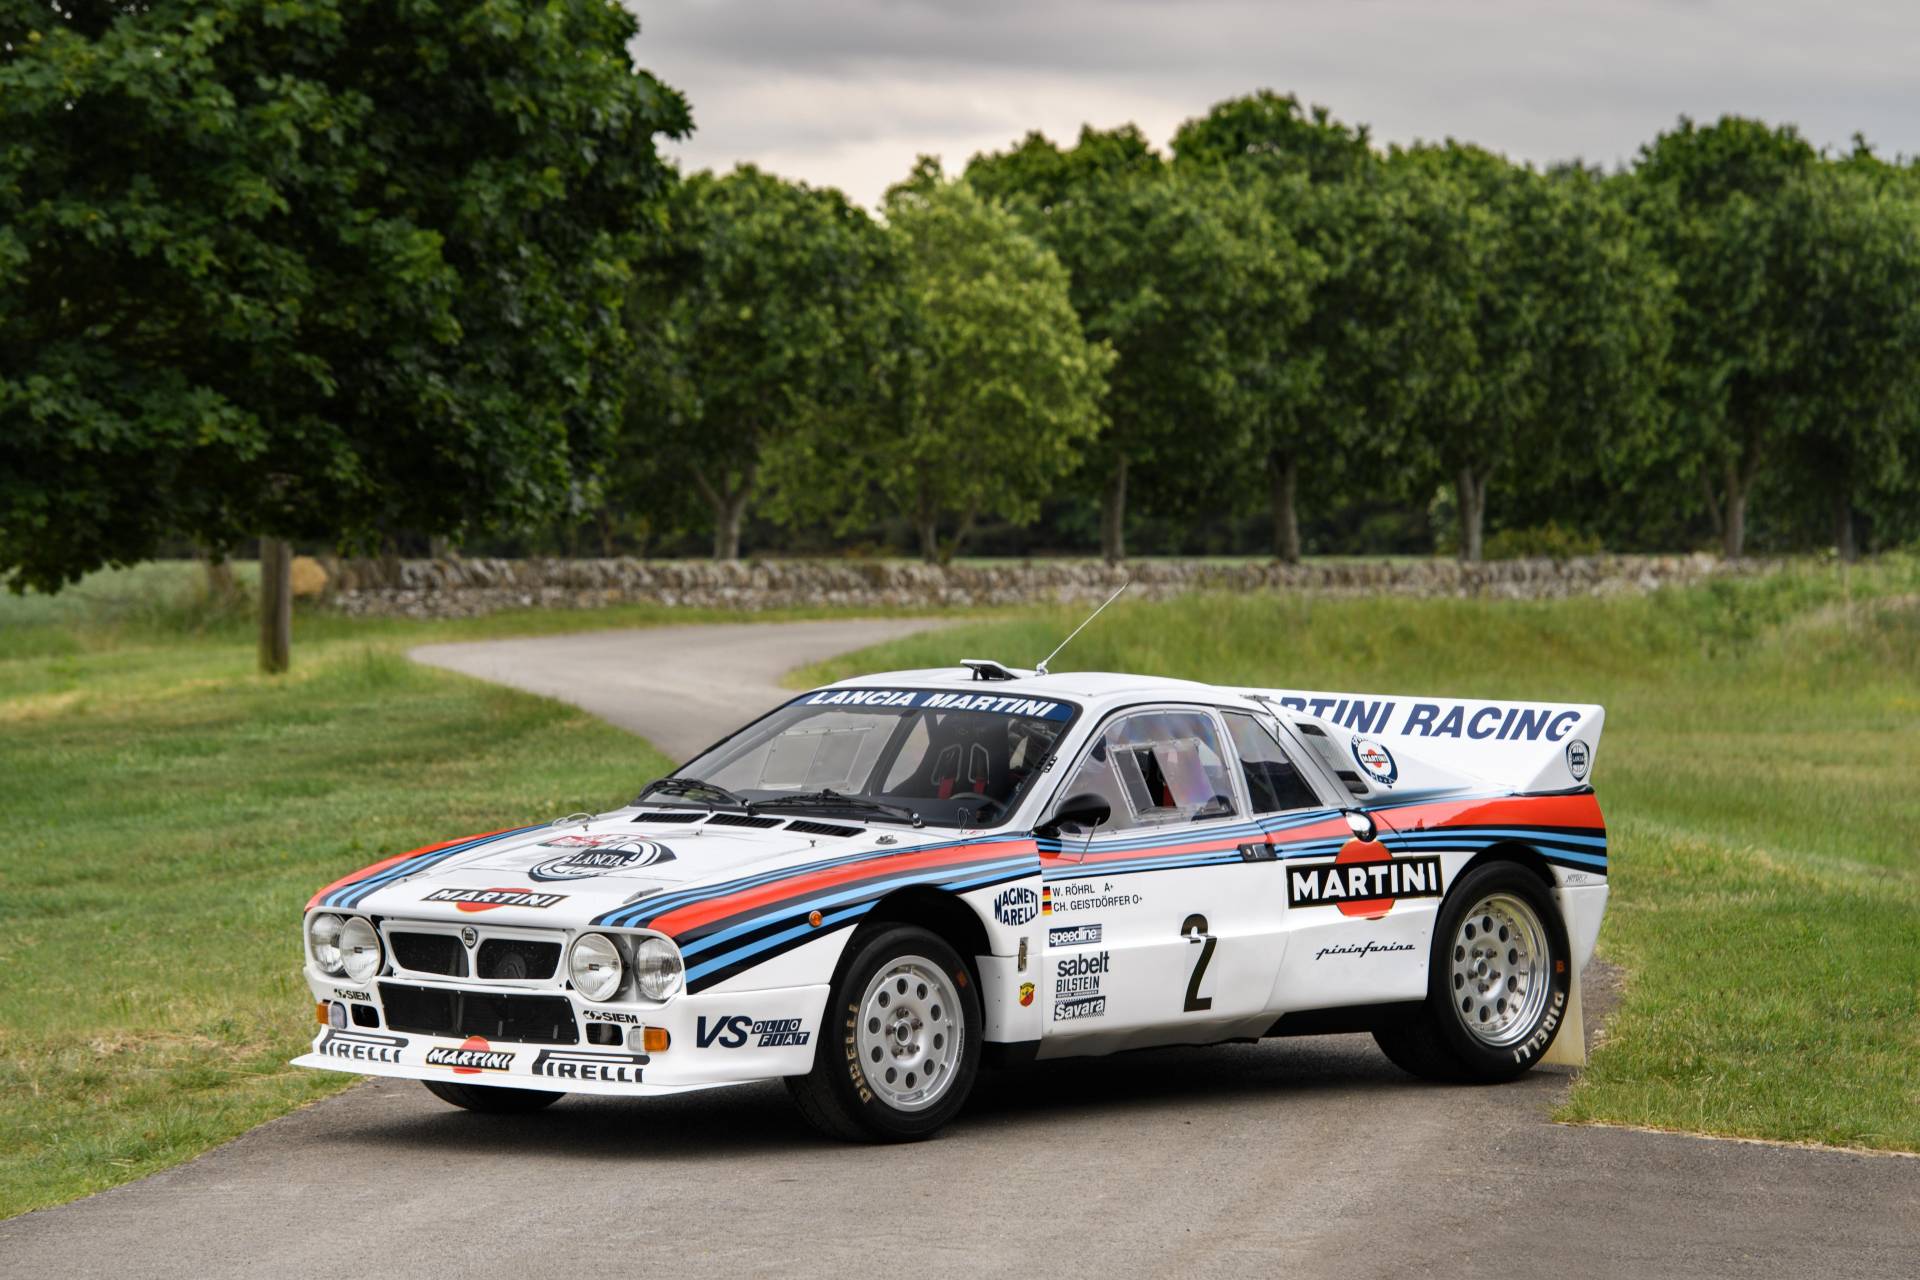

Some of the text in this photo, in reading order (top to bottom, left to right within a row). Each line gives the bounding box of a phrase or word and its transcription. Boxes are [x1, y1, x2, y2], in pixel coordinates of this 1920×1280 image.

[806, 691, 1059, 718] LANCIA MARTINI
[1401, 703, 1581, 742] RACING
[571, 854, 625, 866] LANCIA
[1052, 887, 1063, 897] W.
[1065, 883, 1096, 896] RÖHRL
[1292, 862, 1437, 901] MARTINI
[429, 889, 561, 907] MARTINI
[994, 888, 1038, 915] MAGNETI
[1053, 901, 1069, 913] CH.
[1071, 895, 1130, 911] GEISTDÖRFER
[994, 900, 1038, 926] MARELLI
[1049, 927, 1097, 946] speedline
[1180, 913, 1217, 1012] 2
[1315, 941, 1416, 960] pininfarina
[1057, 951, 1109, 978] sabelt
[346, 990, 372, 1002] SIEM
[1056, 976, 1100, 993] BILSTEIN
[602, 1012, 639, 1024] SIEM
[1055, 999, 1105, 1021] Savara
[696, 1016, 800, 1048] VS OLIO
[760, 1033, 809, 1046] FIAT
[1513, 992, 1565, 1064] PIRELLI
[319, 1029, 409, 1063] PIRELLI
[846, 1003, 872, 1104] PIRELLI
[428, 1049, 514, 1069] MARTINI
[532, 1049, 651, 1083] PIRELLI
